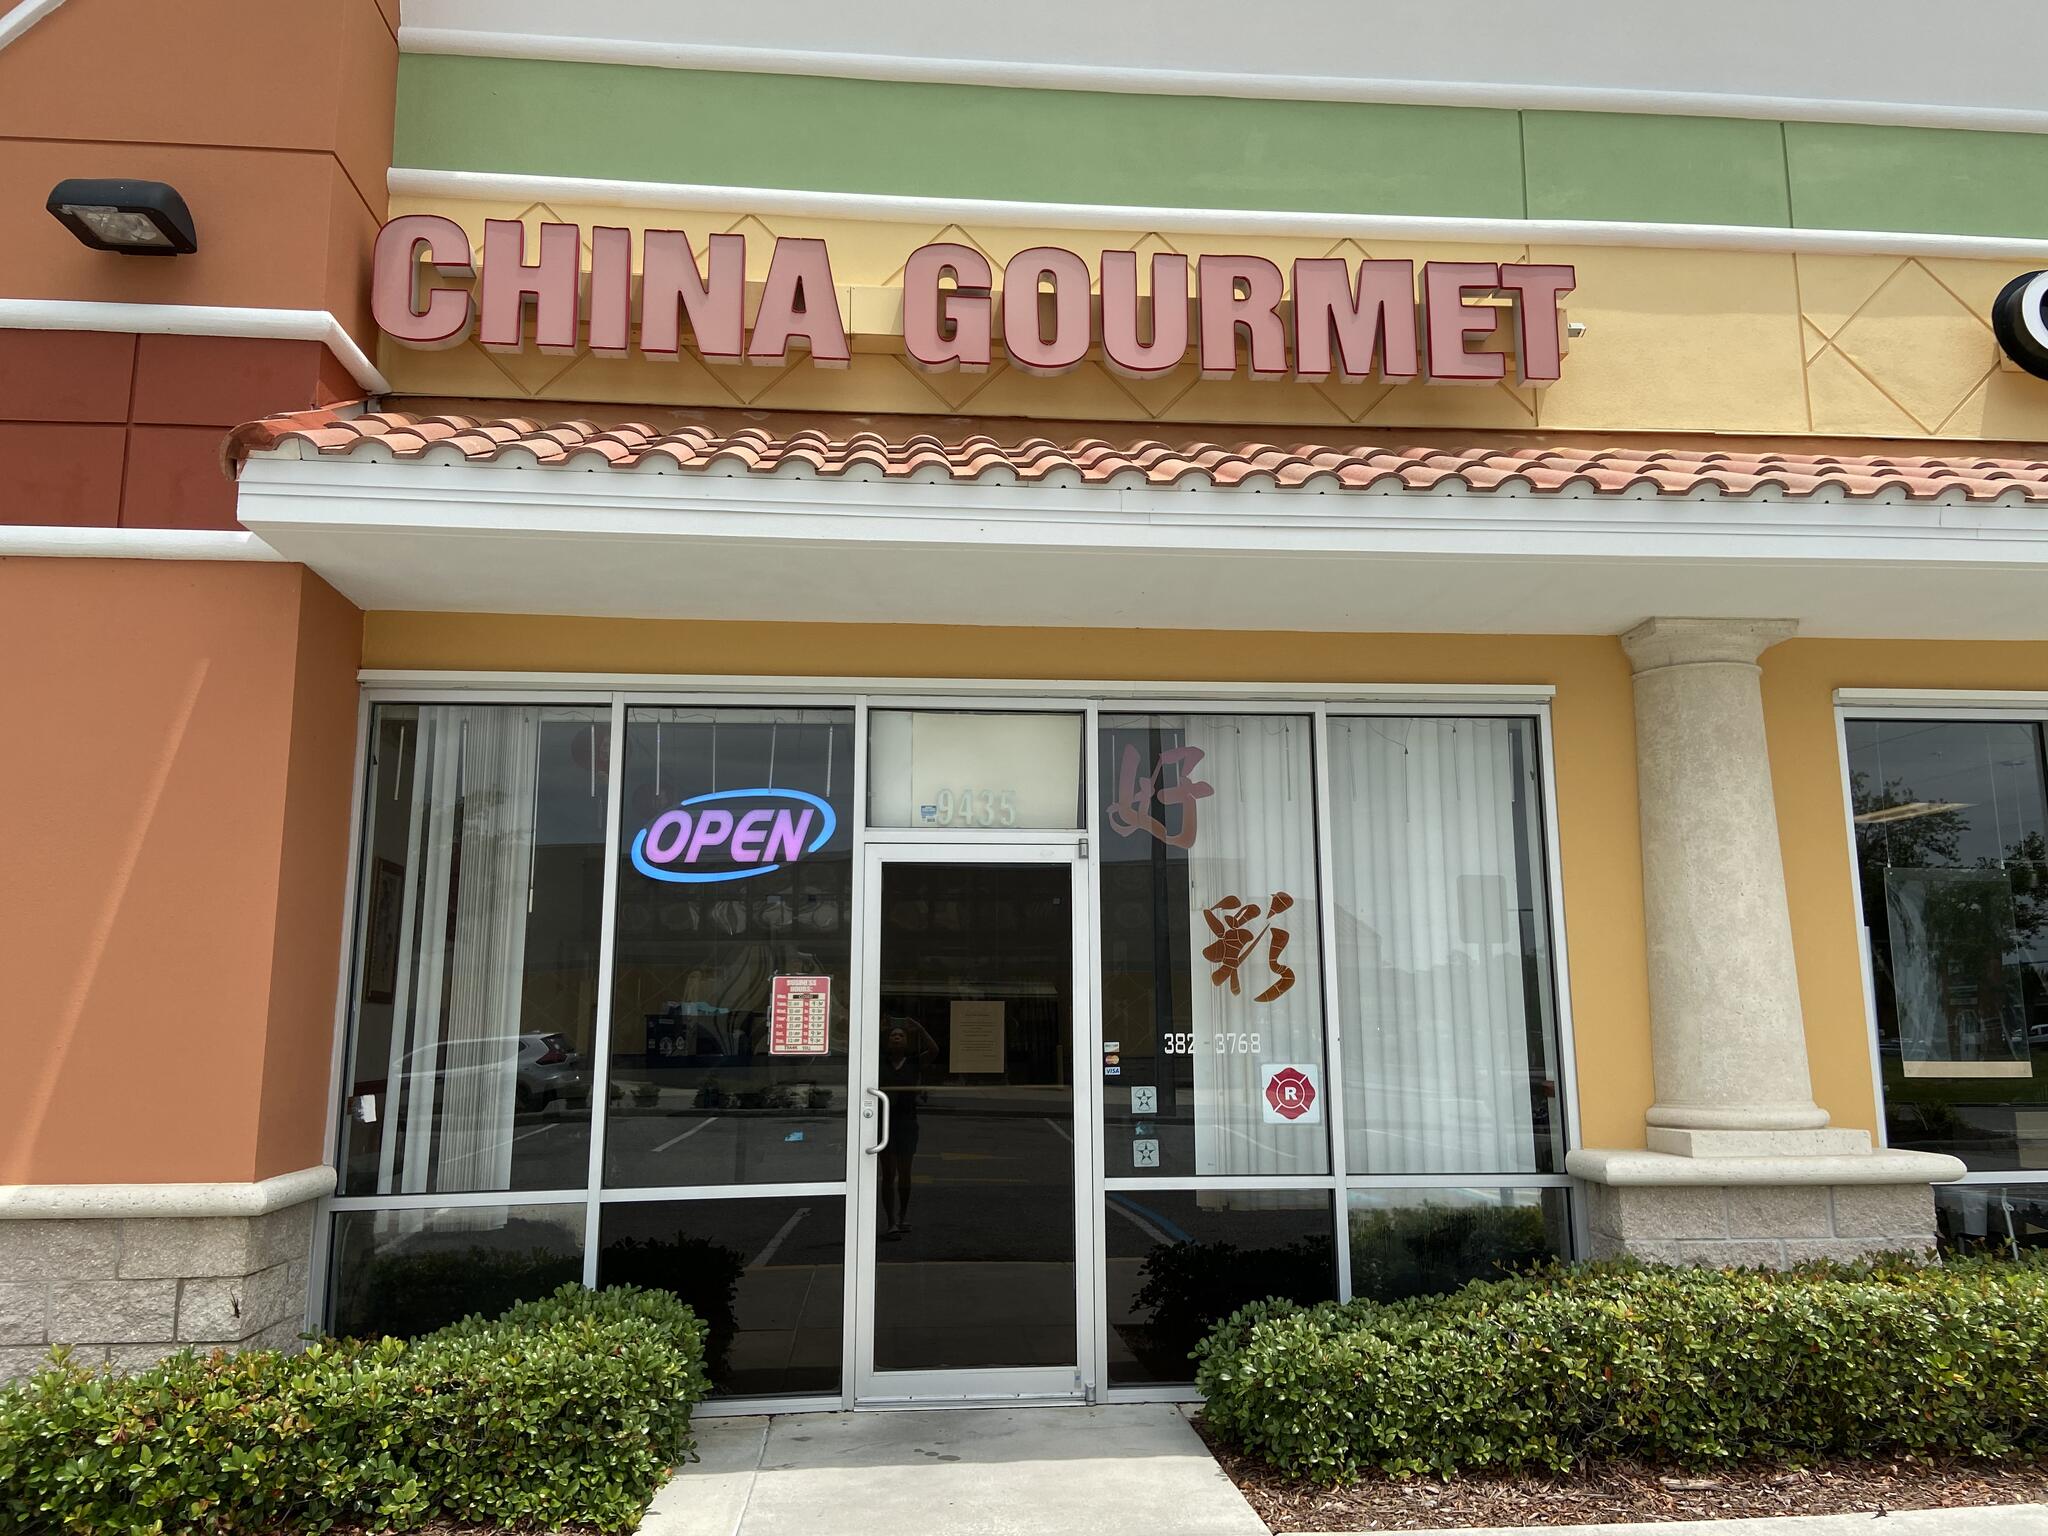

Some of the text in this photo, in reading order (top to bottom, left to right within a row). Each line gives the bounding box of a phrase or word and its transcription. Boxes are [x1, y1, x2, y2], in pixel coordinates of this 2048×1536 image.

[371, 214, 1576, 384] CHINA GOURMET
[936, 788, 1016, 826] 9435
[1106, 744, 1215, 849] 好
[646, 809, 814, 864] OPEN
[1284, 1087, 1298, 1101] R
